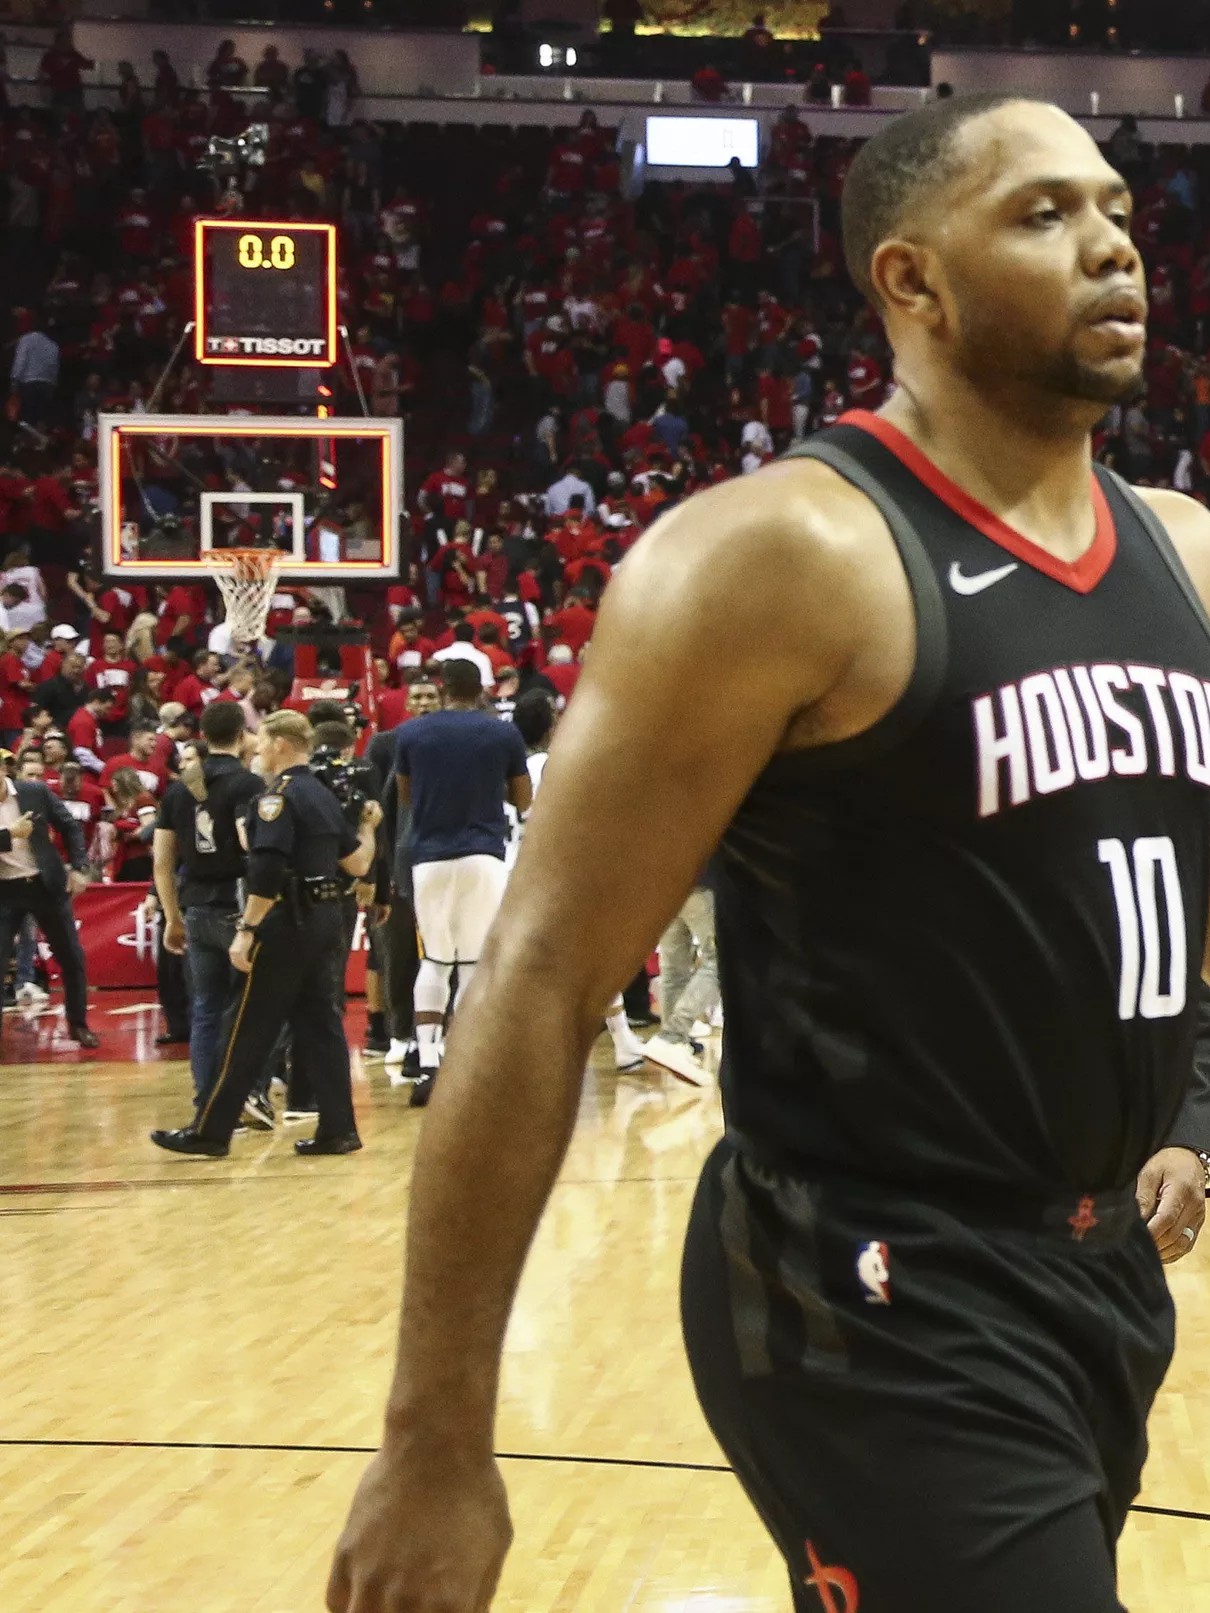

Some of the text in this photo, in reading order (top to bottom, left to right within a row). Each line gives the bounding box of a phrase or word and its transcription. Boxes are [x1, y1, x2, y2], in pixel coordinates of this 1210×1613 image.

[239, 234, 295, 269] 0.0
[240, 337, 326, 355] TISSOT
[1098, 836, 1187, 1020] 10
